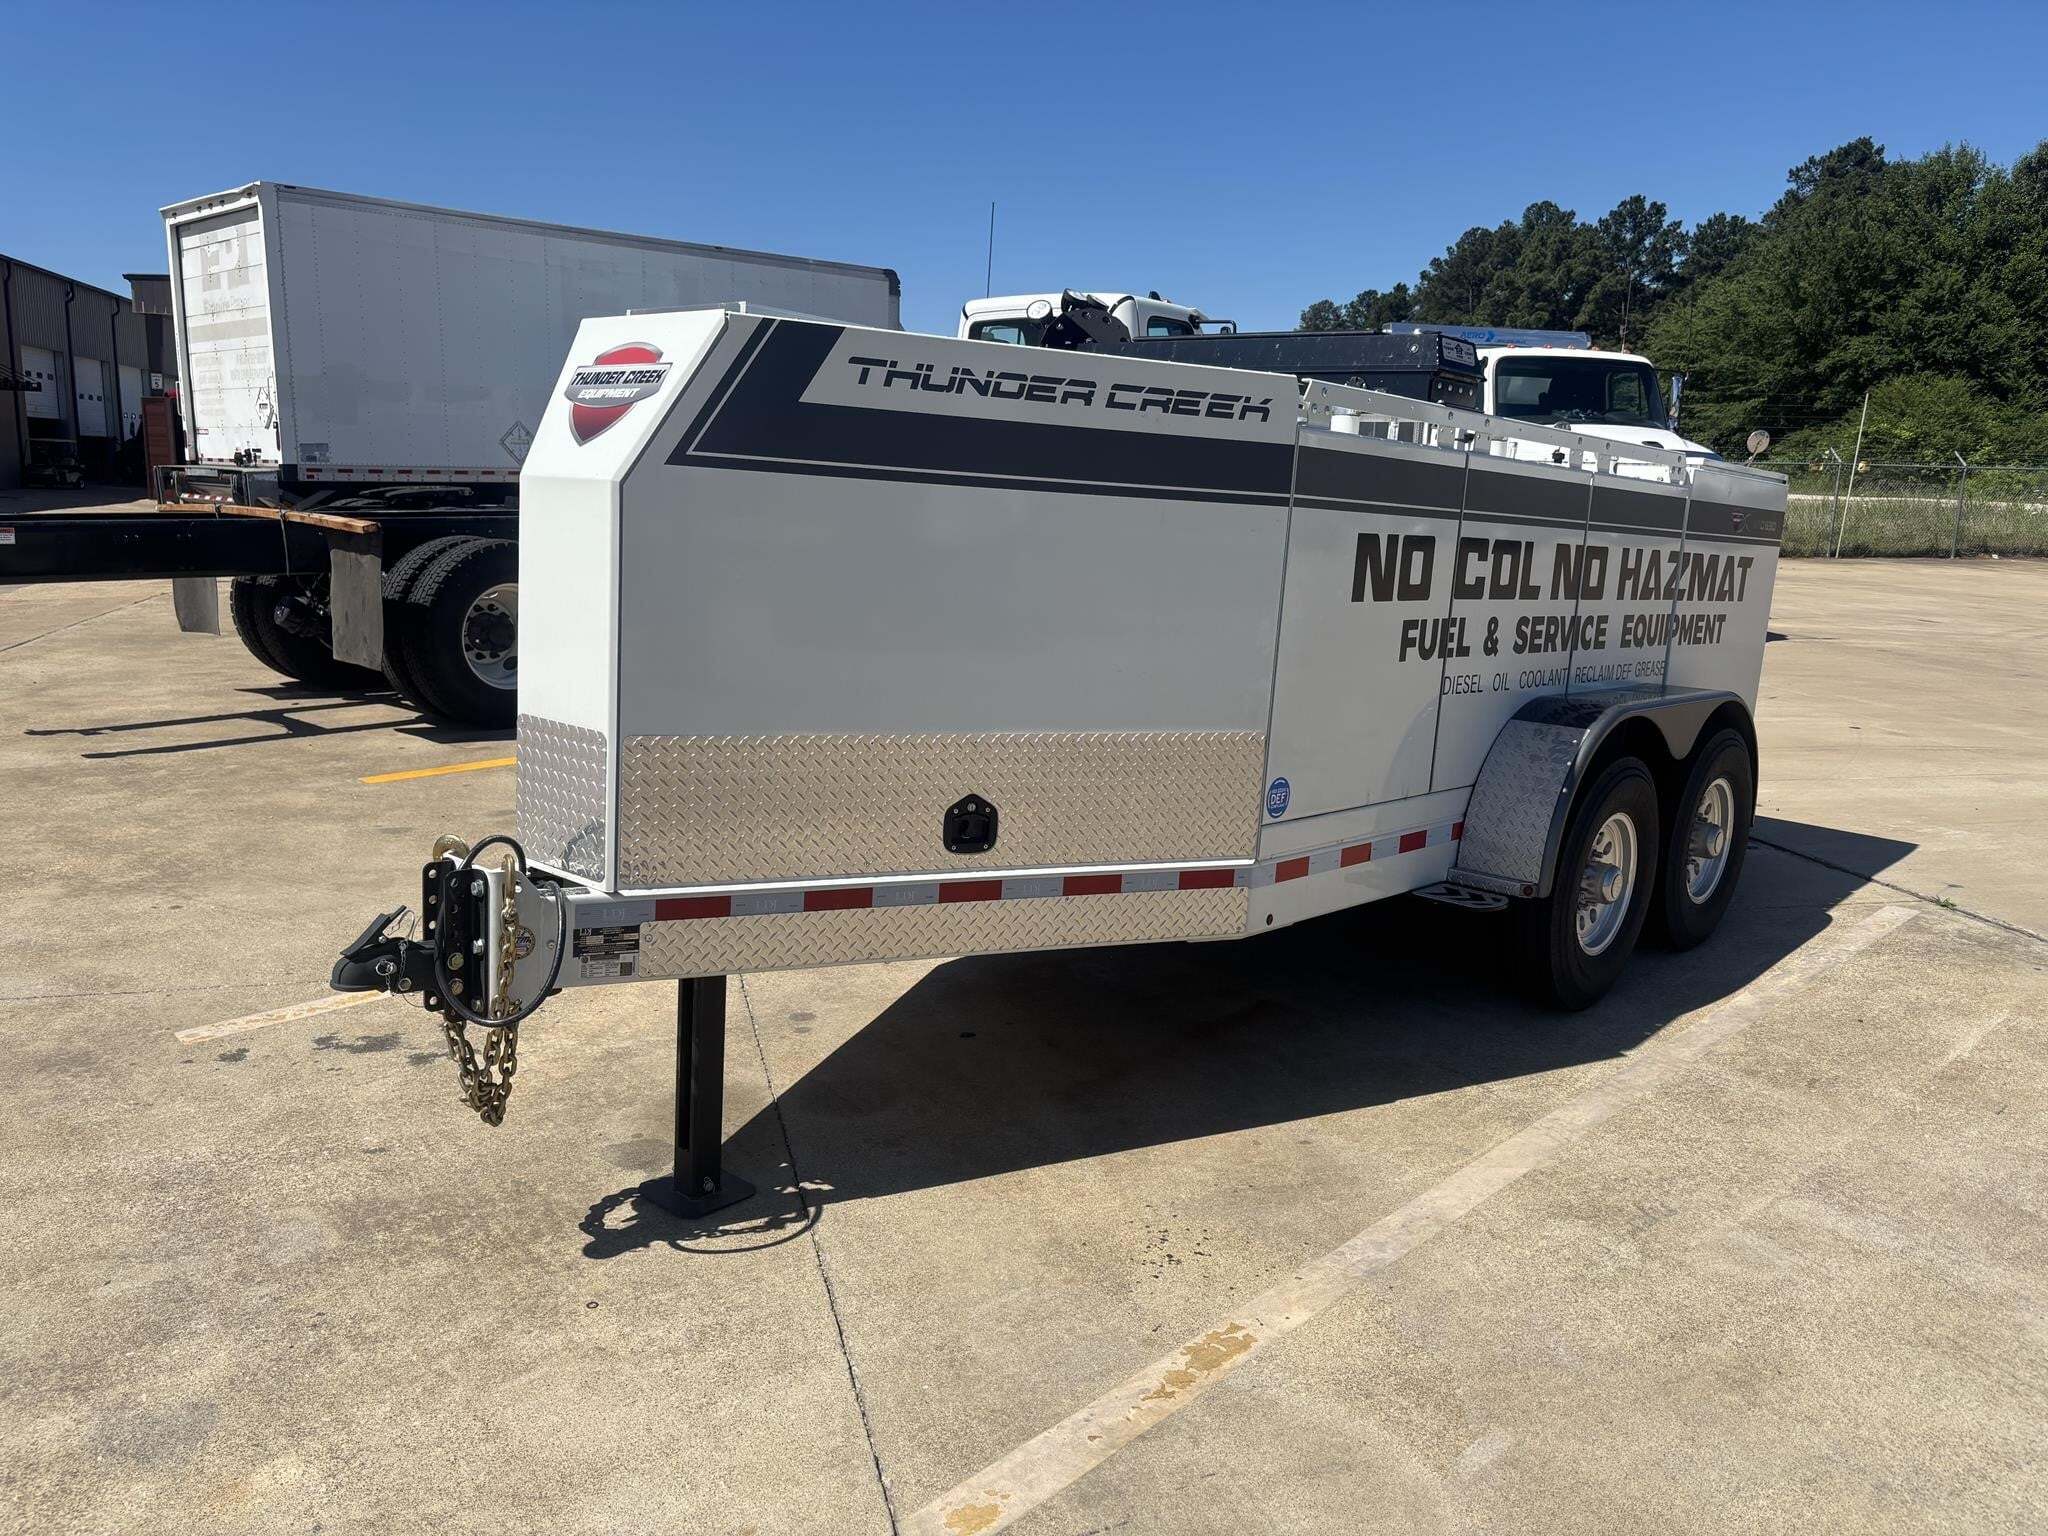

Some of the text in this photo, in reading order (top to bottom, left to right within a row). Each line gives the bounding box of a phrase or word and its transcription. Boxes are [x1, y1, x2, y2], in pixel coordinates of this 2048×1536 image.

[571, 370, 667, 386] THUNDER CREEK
[577, 387, 640, 399] EQUIPMENT
[848, 355, 1274, 423] THUNDER CREEK
[1351, 533, 1754, 602] NO CDL NO HAZMAT
[1399, 614, 1726, 662] FUEL & SERVICE EQUIPMENT
[1442, 660, 1665, 696] DIESEL OIL COOLANT RECLAIM DEF GREASE
[1271, 792, 1286, 805] DEF
